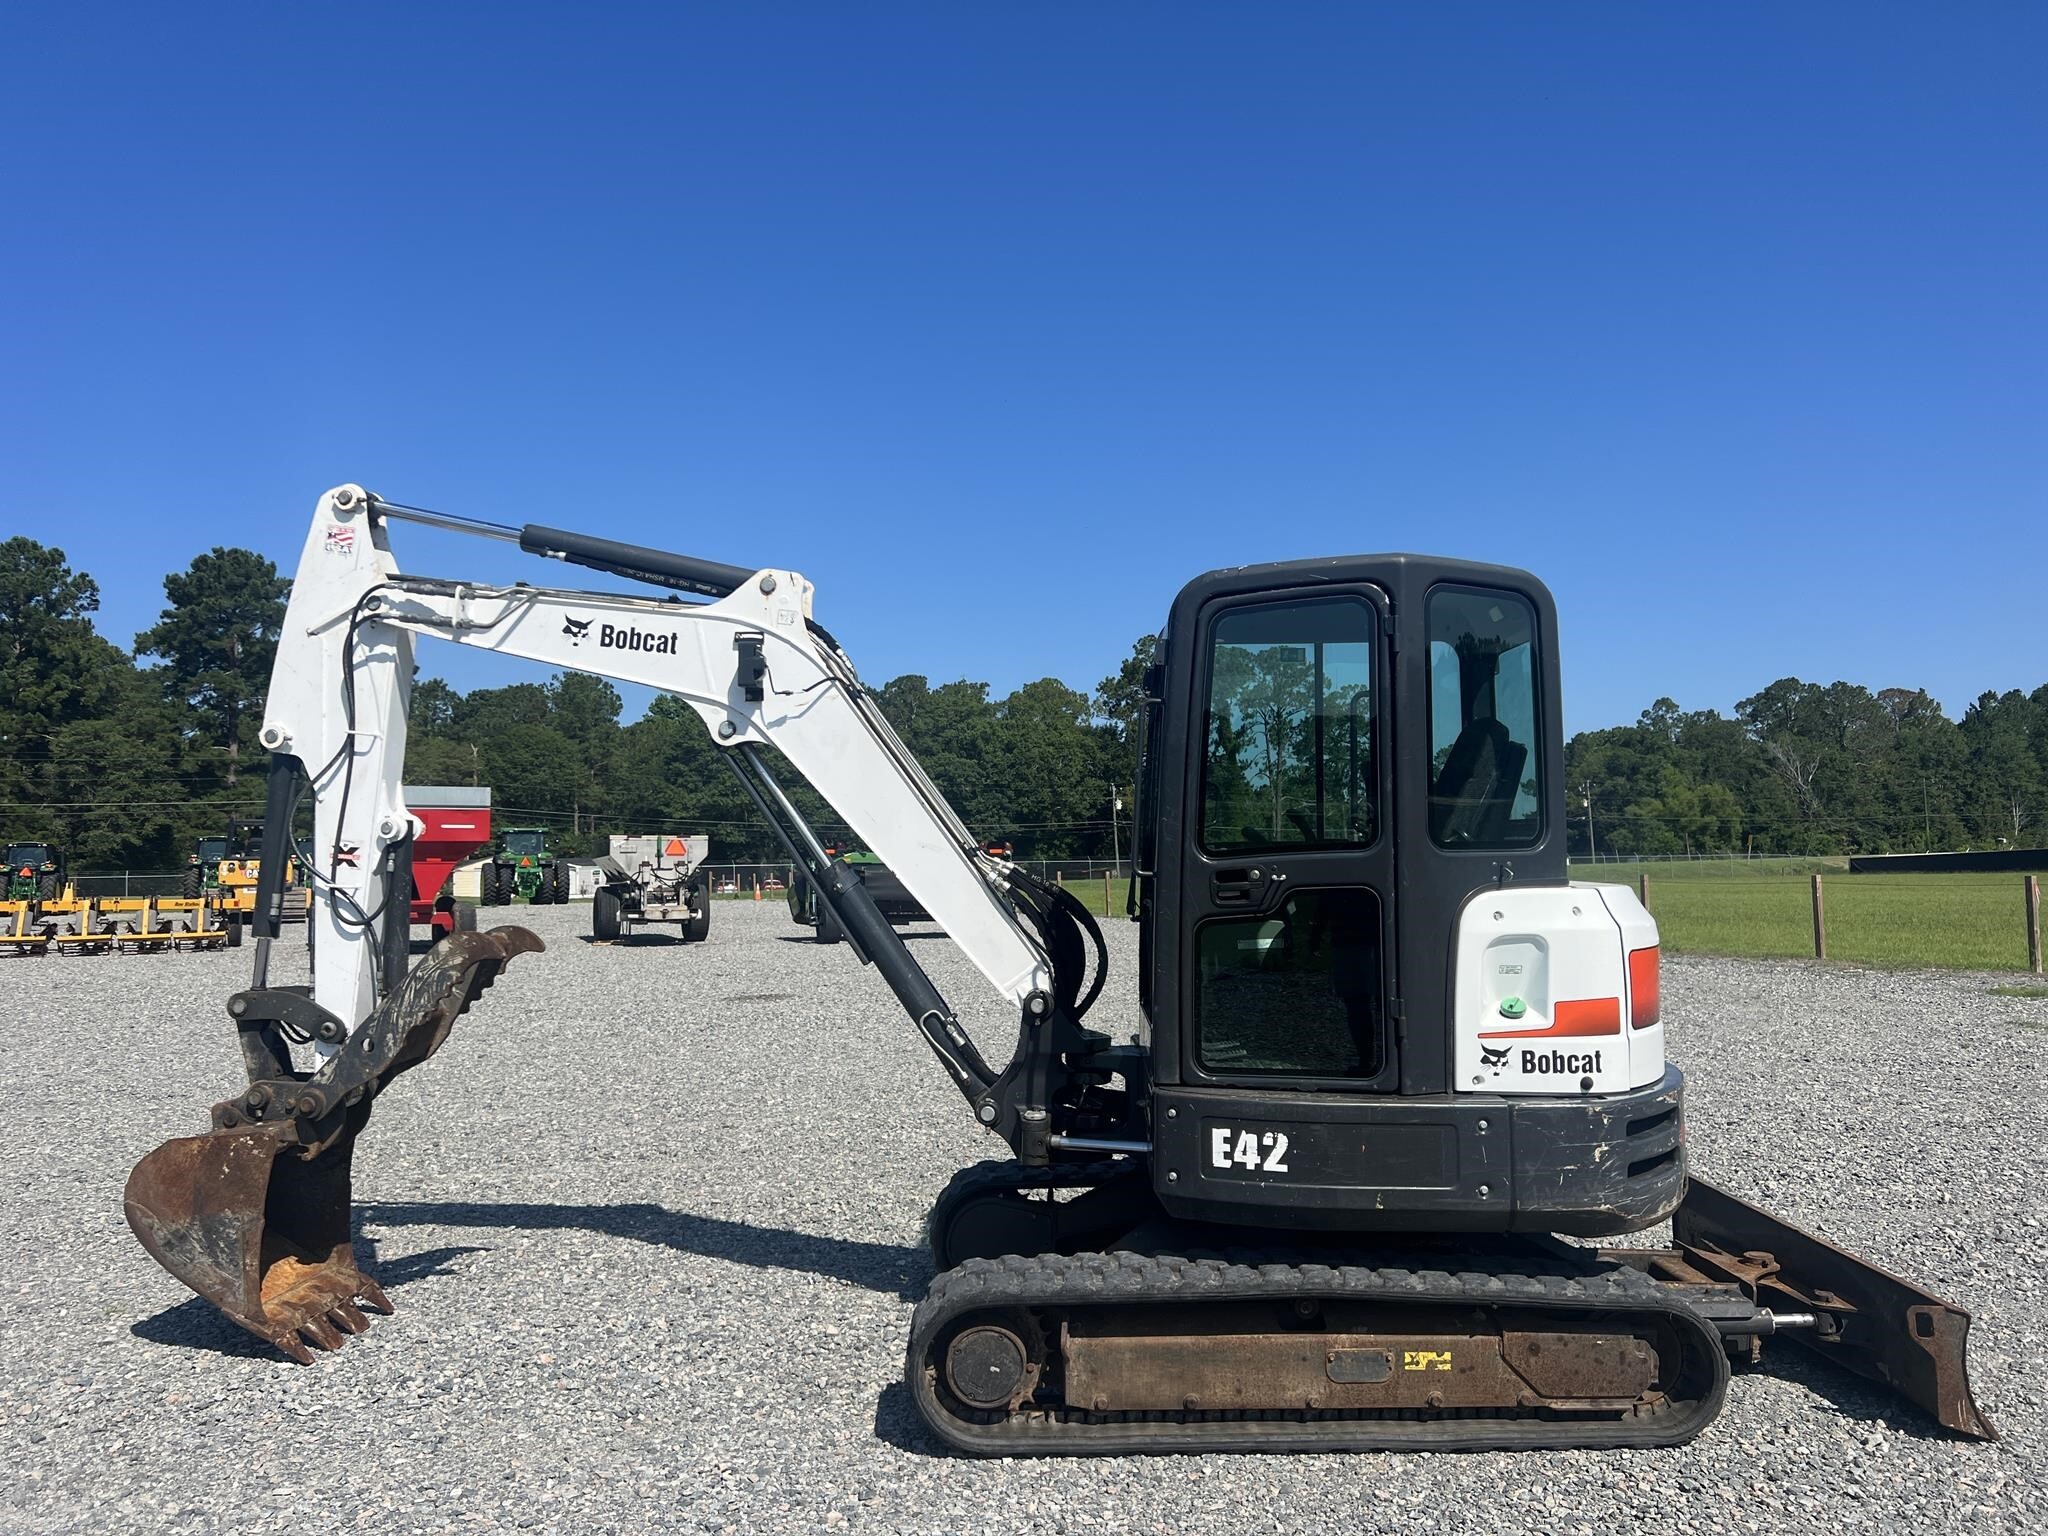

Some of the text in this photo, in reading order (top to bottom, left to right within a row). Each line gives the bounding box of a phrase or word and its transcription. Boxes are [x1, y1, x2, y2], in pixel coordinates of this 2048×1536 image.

[600, 624, 678, 655] Bobcat
[246, 869, 260, 878] CA
[1521, 1049, 1602, 1075] Bobcat
[1212, 1128, 1289, 1173] E42
